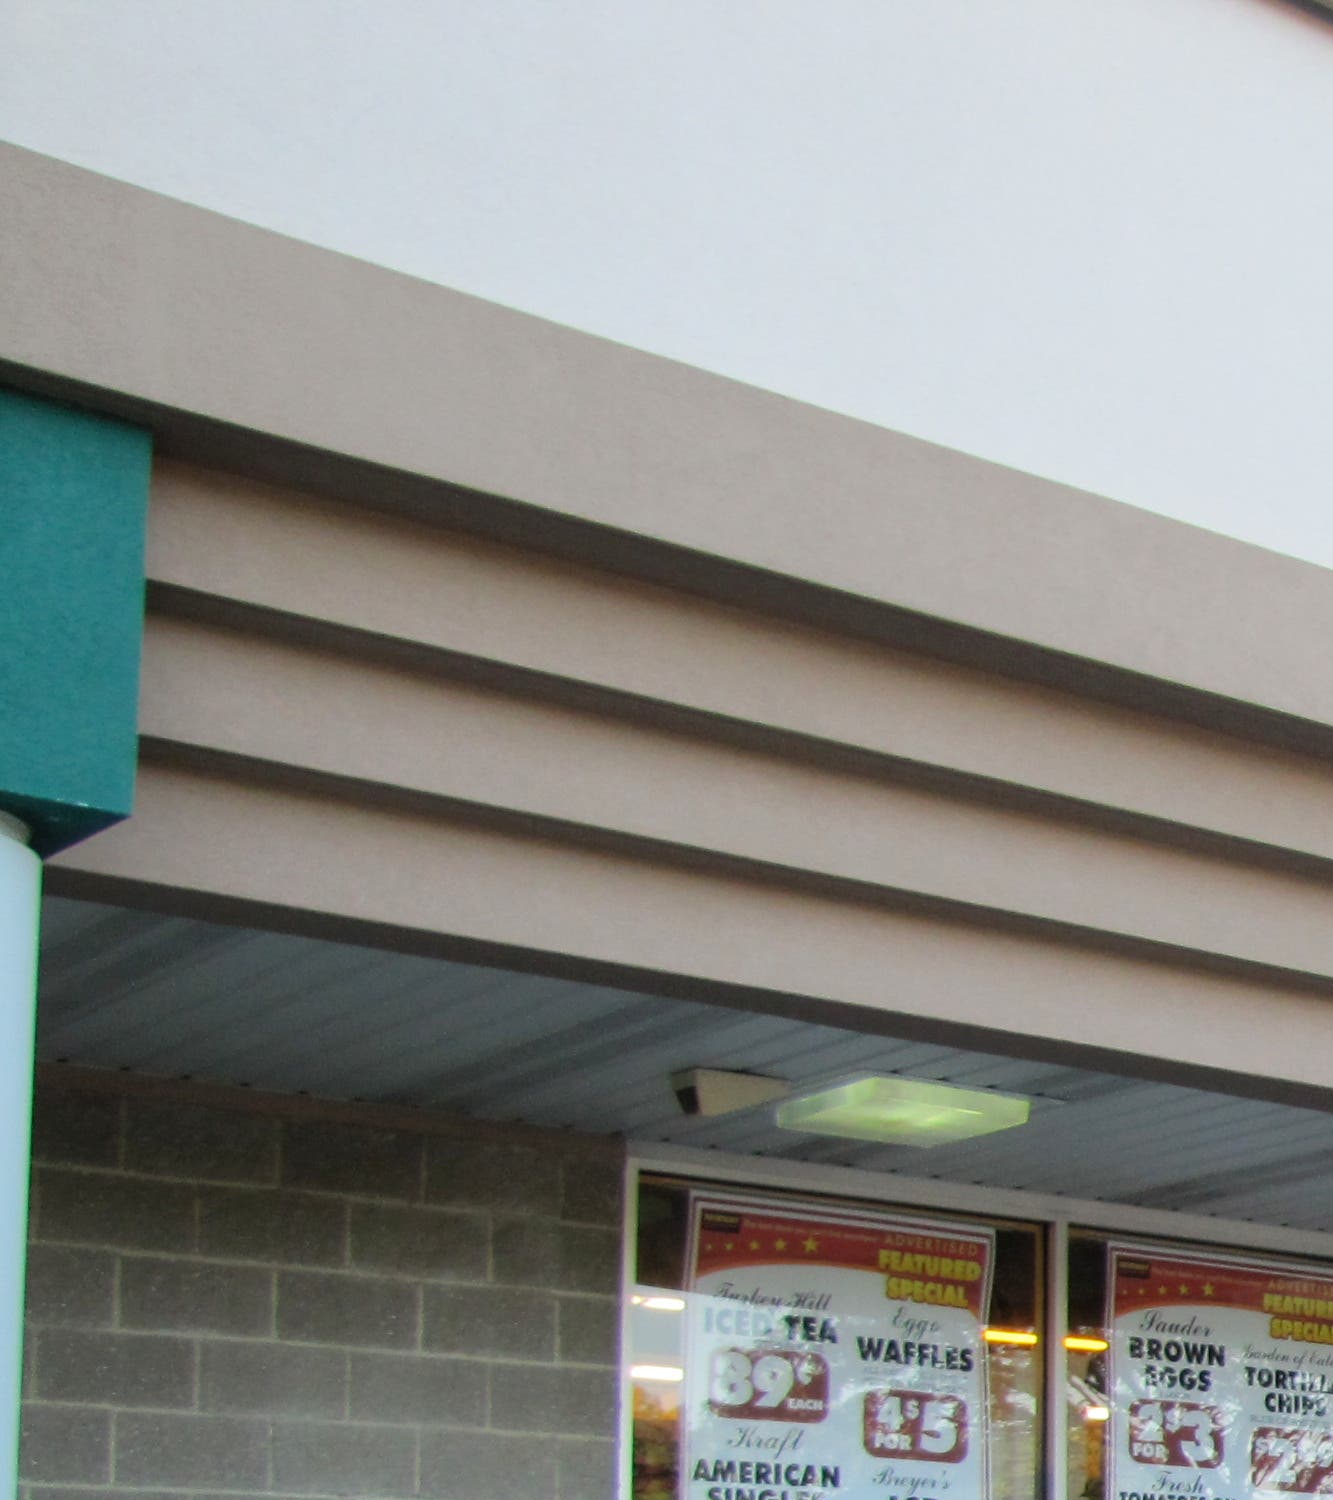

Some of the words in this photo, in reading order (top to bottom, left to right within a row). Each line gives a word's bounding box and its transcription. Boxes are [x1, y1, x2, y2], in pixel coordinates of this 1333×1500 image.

[884, 1235, 978, 1257] ADVERTISED
[879, 1250, 982, 1282] FEATURED
[713, 1282, 784, 1307] Turkey
[787, 1291, 832, 1310] Hill
[886, 1276, 969, 1308] SPECIAL
[704, 1307, 773, 1337] ICED
[783, 1314, 839, 1343] TEA
[1139, 1309, 1213, 1338] Sauder
[856, 1336, 974, 1372] WAFFLES
[1128, 1336, 1226, 1367] BROWN
[1145, 1365, 1212, 1392] EGGS
[787, 1399, 824, 1411] EACH
[1264, 1392, 1328, 1416] CHIPS
[726, 1427, 804, 1459] Kraft
[874, 1432, 913, 1450] FOR
[1132, 1442, 1167, 1458] FOR
[692, 1458, 840, 1488] AMERICAN
[871, 1465, 953, 1495] Breyer's
[1152, 1472, 1204, 1491] Fresh
